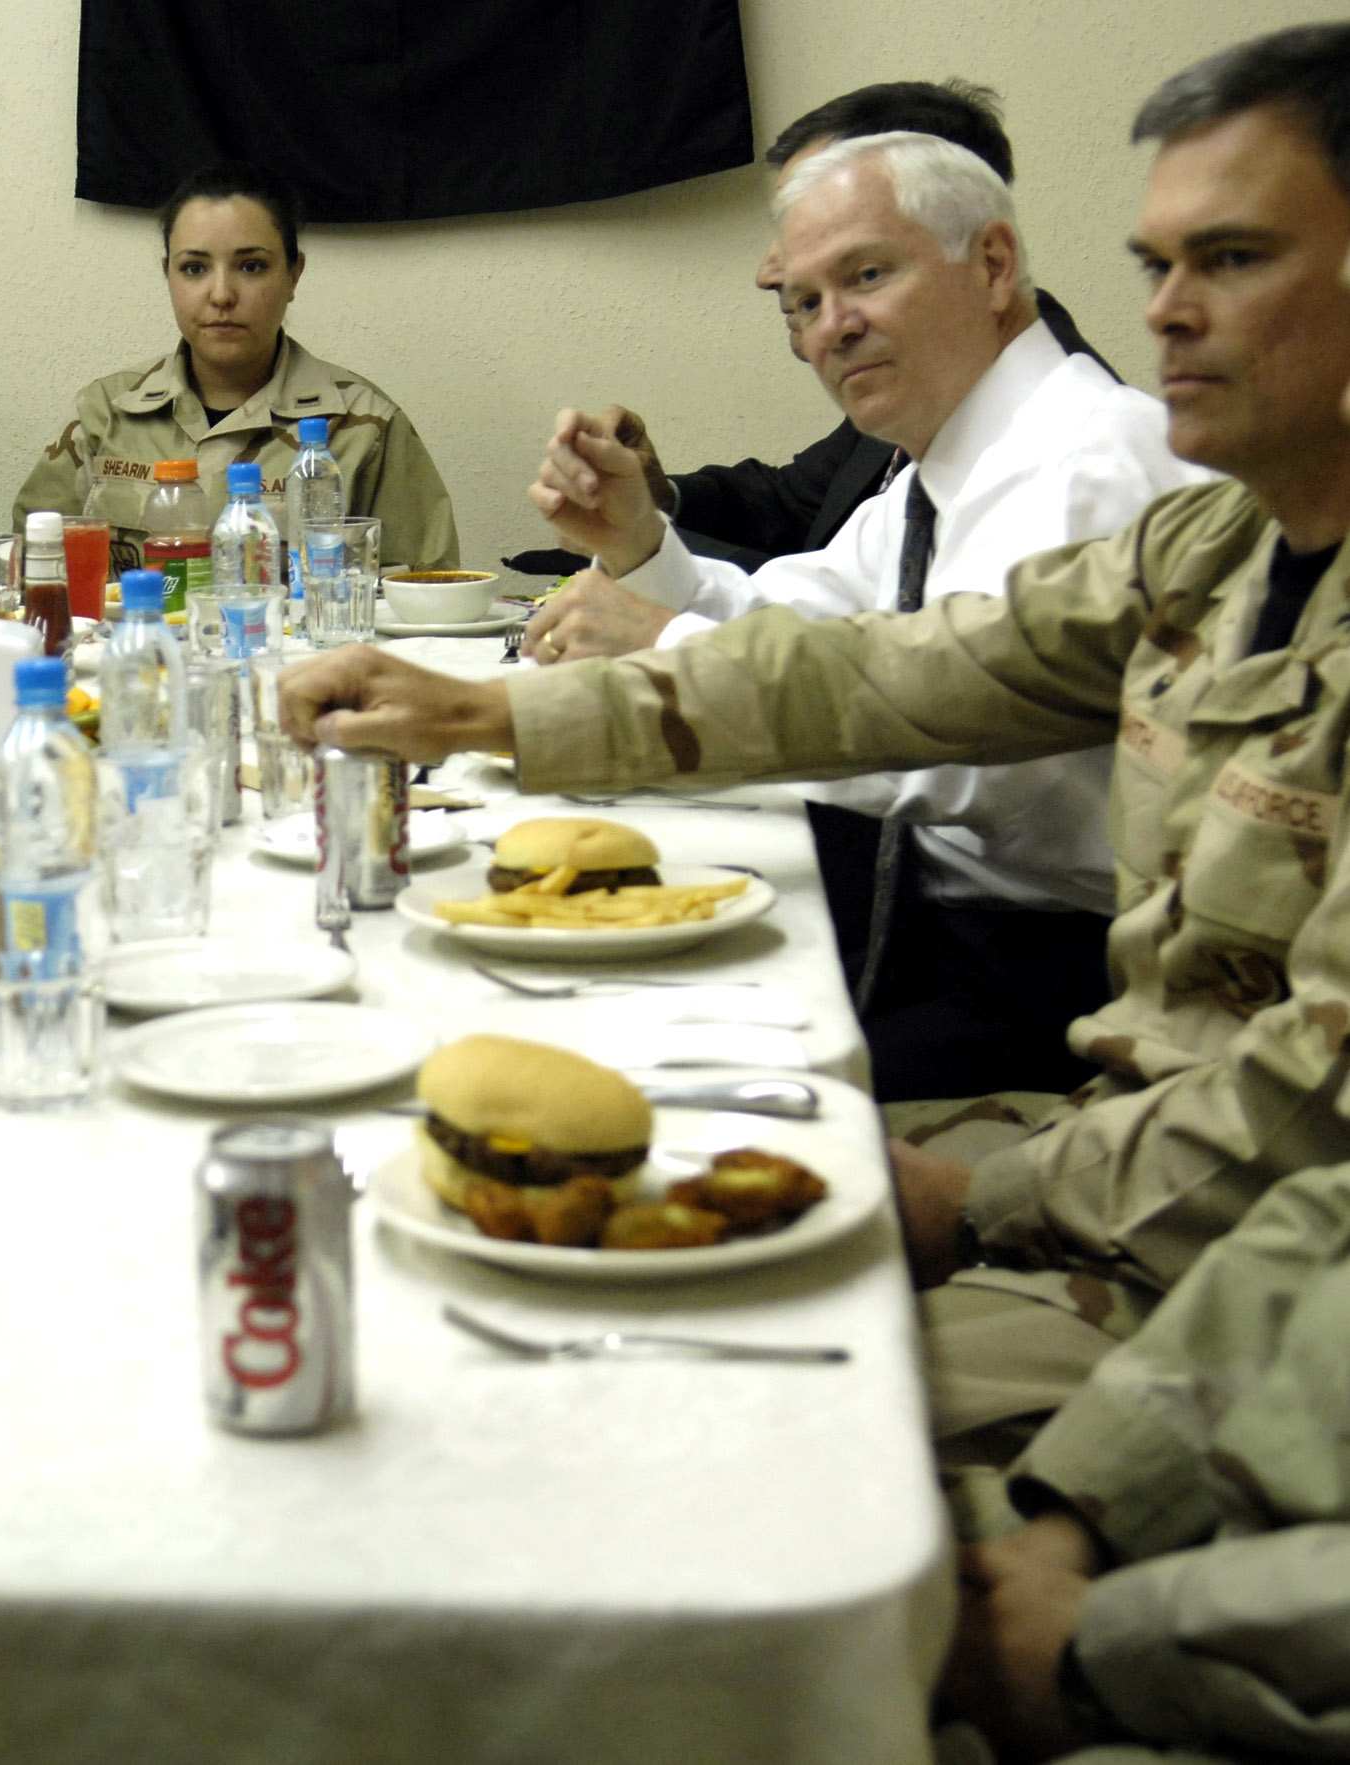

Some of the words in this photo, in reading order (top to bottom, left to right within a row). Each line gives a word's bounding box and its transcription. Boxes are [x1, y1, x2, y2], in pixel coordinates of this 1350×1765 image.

[102, 459, 151, 480] SHEARIN
[271, 477, 286, 492] AI
[221, 1196, 301, 1389] Coke
